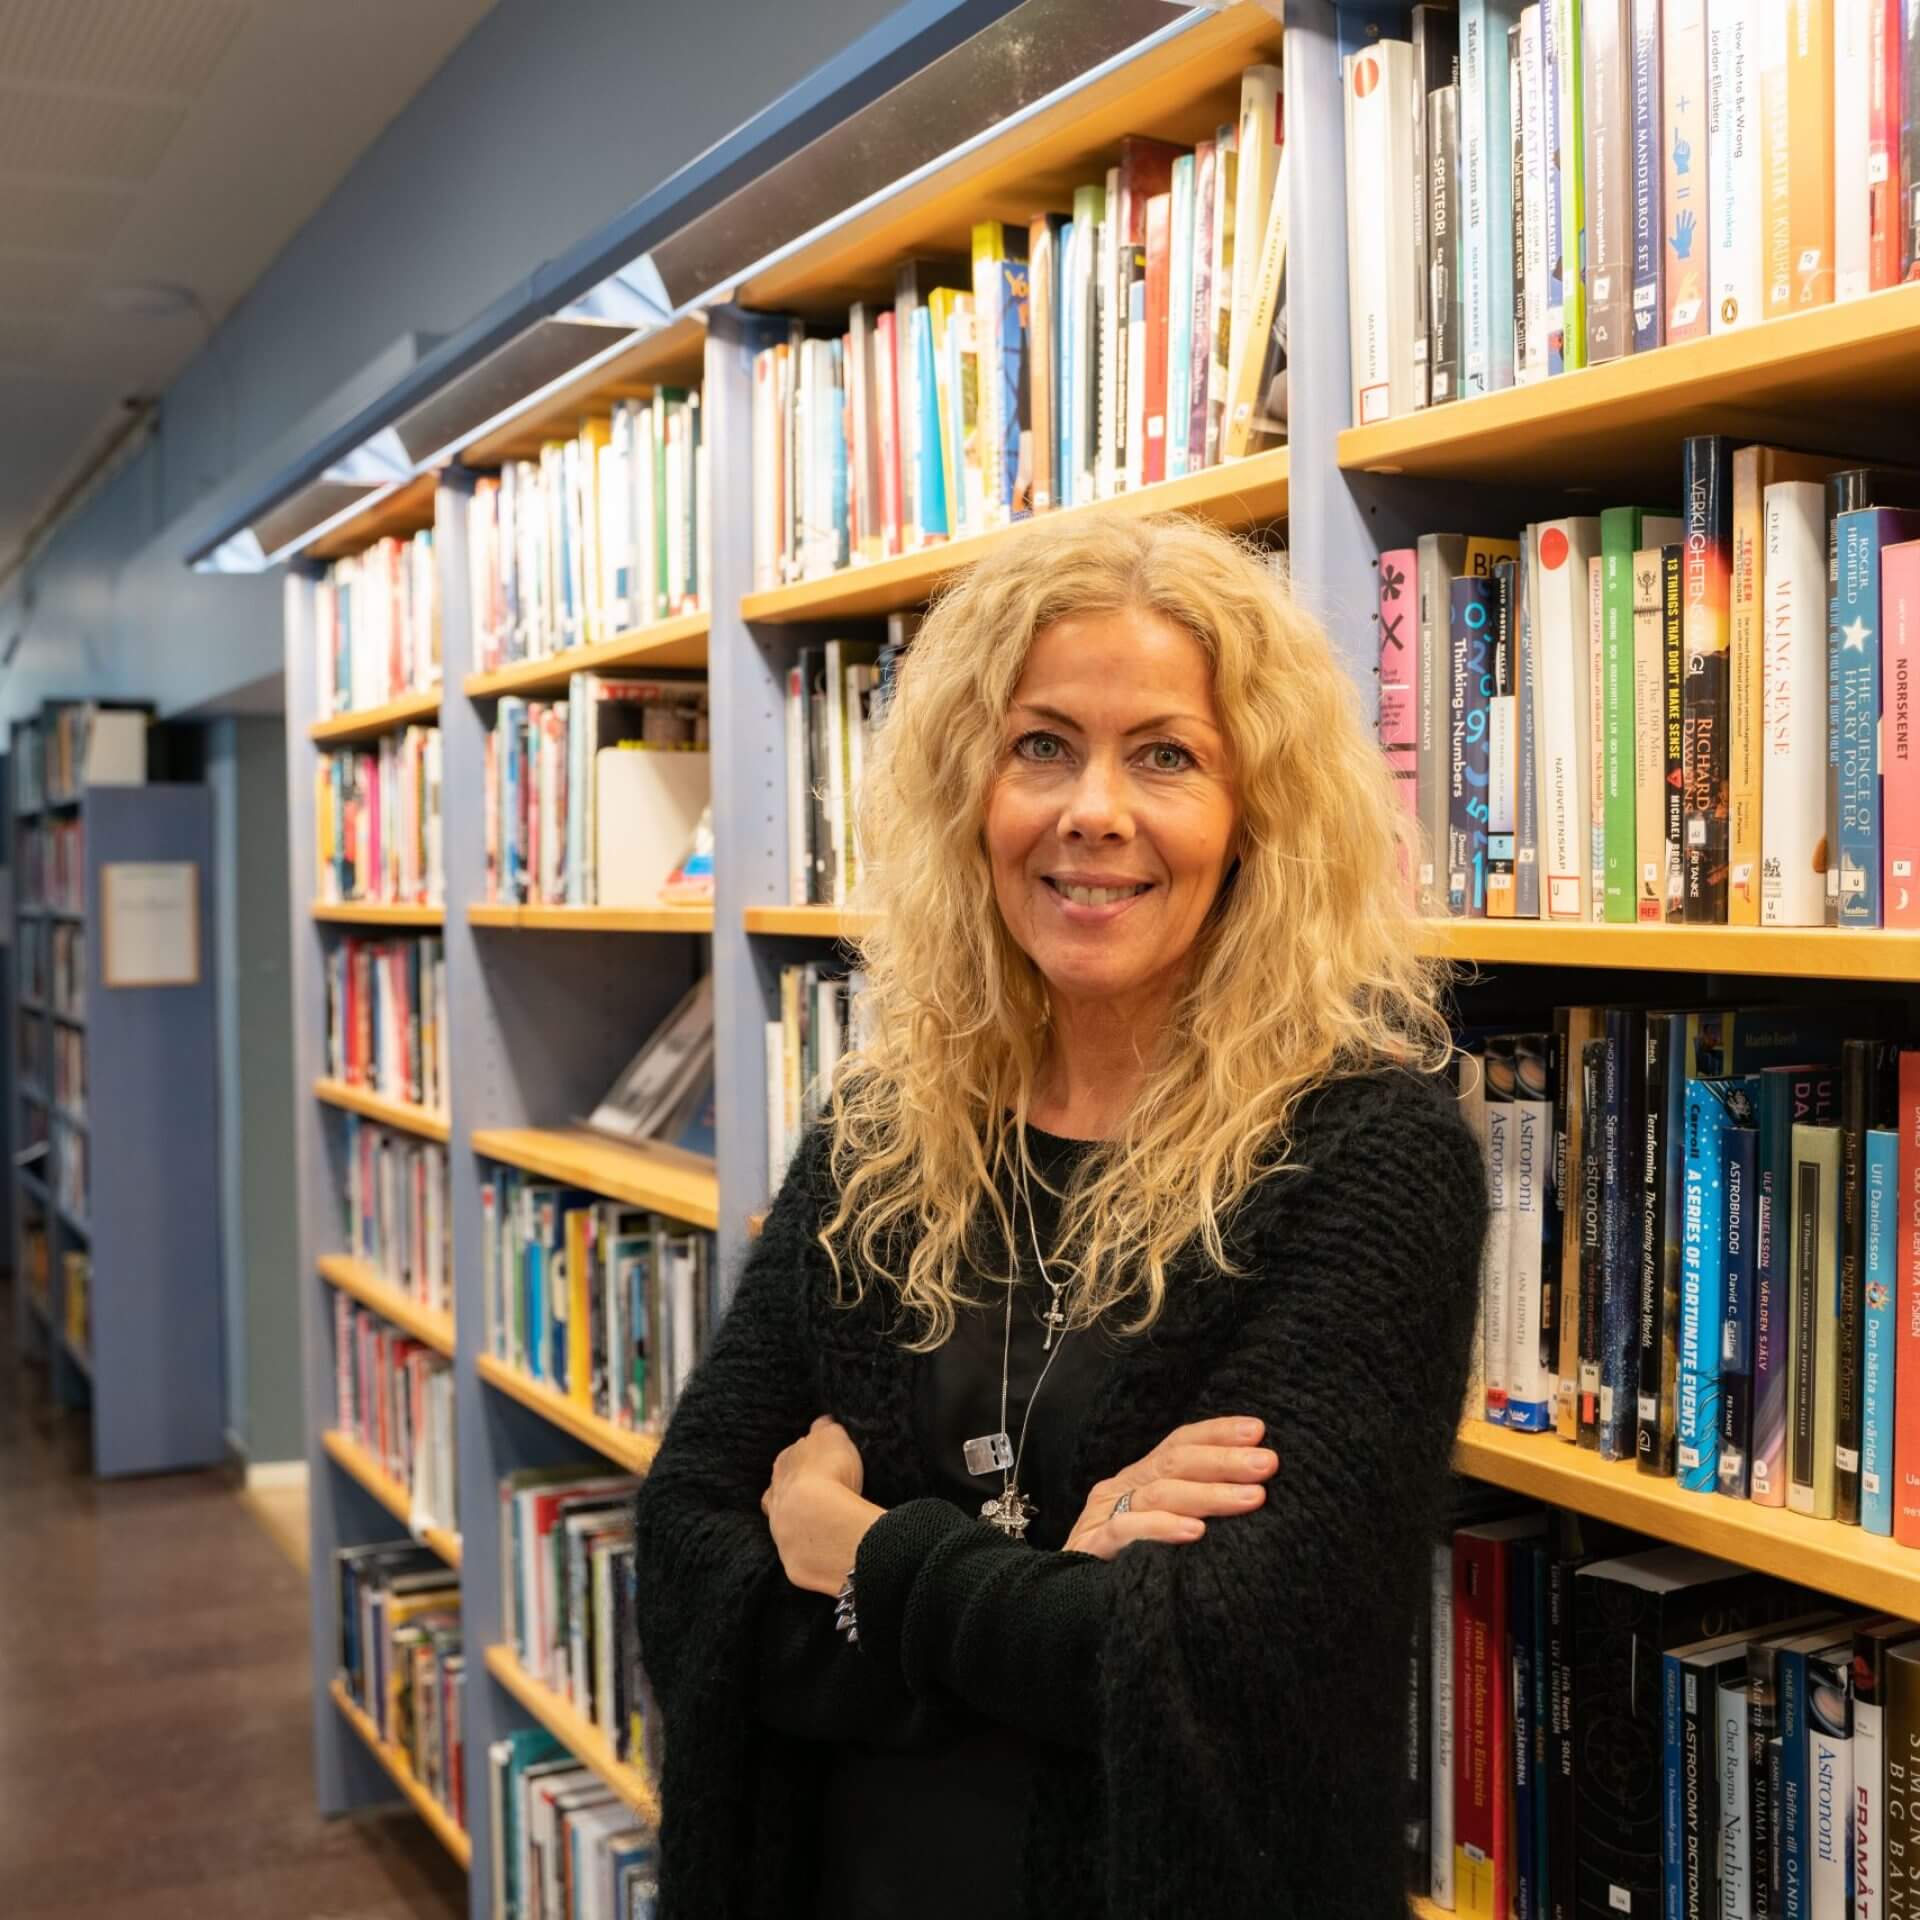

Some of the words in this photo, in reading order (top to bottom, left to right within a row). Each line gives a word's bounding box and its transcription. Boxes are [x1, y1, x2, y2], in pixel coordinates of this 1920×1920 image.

[1710, 28, 1721, 71] Jordan
[1734, 21, 1745, 51] How
[1735, 54, 1745, 79] Not
[1735, 80, 1744, 93] to
[1524, 37, 1538, 179] MATEMATIK
[1710, 73, 1722, 134] Ellenberg
[1735, 97, 1745, 112] Be
[1733, 115, 1745, 160] Wrong
[1434, 157, 1446, 237] SPELTEORI
[1514, 178, 1522, 200] som
[1637, 128, 1650, 241] MANDELBROT
[1470, 199, 1480, 228] allt
[1515, 214, 1523, 238] värt
[1722, 196, 1735, 249] Thinking
[1515, 239, 1523, 254] att
[1515, 255, 1523, 280] veta
[1638, 243, 1649, 273] SET
[1515, 289, 1526, 319] Tony
[1367, 313, 1377, 381] MATEMATIK
[1769, 512, 1780, 555] DEAN
[1667, 558, 1678, 572] 13
[1743, 538, 1753, 603] TEORIER
[1847, 526, 1858, 605] HIGHFIELD
[1858, 536, 1870, 591] ROGER
[1667, 574, 1679, 618] THINGS
[1668, 619, 1679, 648] THAT
[1775, 580, 1792, 673] MAKING
[1451, 637, 1467, 709] Thinking
[1499, 644, 1507, 686] WALLACE
[1667, 650, 1680, 686] DON'T
[1857, 664, 1871, 706] THE
[1636, 660, 1650, 727] Influential
[1648, 680, 1660, 707] The
[1668, 688, 1680, 720] MAKE
[1844, 669, 1858, 742] HARRY
[1895, 657, 1909, 762] NORRSKENET
[1423, 707, 1434, 752] ANALYS
[1525, 711, 1534, 733] och
[1648, 709, 1661, 733] 100
[1774, 681, 1792, 757] SENSE
[1452, 721, 1468, 799] Numbers
[1637, 729, 1650, 787] Scientists
[1649, 735, 1662, 768] Most
[1669, 722, 1681, 760] SENSE
[1857, 710, 1872, 802] SCIENCE
[1683, 718, 1697, 817] DAWKINS
[1695, 717, 1713, 813] RICHARD
[1523, 751, 1535, 846] vardagsmatematik
[1843, 749, 1857, 834] POTTER
[1554, 756, 1568, 871] NATURVETENSKAP
[1669, 795, 1681, 842] MICHAEL
[1736, 817, 1744, 845] Parsons
[1858, 806, 1872, 837] OF
[1457, 833, 1467, 866] Daniel
[1690, 850, 1699, 865] FRI
[1690, 866, 1700, 899] TANKE
[1647, 1039, 1657, 1065] Beech
[1605, 1114, 1618, 1185] Stjärnhimlen
[1645, 1112, 1658, 1184] Terraforming
[1690, 1104, 1701, 1159] Carroll
[1843, 1131, 1856, 1159] John
[1490, 1110, 1509, 1214] Astronomi
[1518, 1108, 1538, 1214] Astronomi
[1555, 1131, 1568, 1213] Astrobiologi
[1687, 1168, 1702, 1182] A
[1762, 1170, 1772, 1194] ULF
[1871, 1162, 1883, 1184] Ulf
[1585, 1154, 1602, 1248] astronomi
[1645, 1191, 1656, 1209] The
[1685, 1184, 1702, 1243] SERIES
[1727, 1160, 1741, 1256] ASTROBIOLOGI
[1803, 1213, 1811, 1227] Ulf
[1843, 1180, 1856, 1224] Barrow
[1643, 1210, 1655, 1252] Creating
[1760, 1195, 1772, 1268] DANIELSSON
[1869, 1189, 1882, 1271] Danielsson
[1643, 1252, 1655, 1266] of
[1685, 1245, 1700, 1269] OF
[1518, 1271, 1529, 1292] IAN
[1604, 1268, 1612, 1304] NATTEN
[1642, 1265, 1654, 1314] Habitable
[1727, 1272, 1738, 1304] David
[1516, 1295, 1528, 1345] RIDPATH
[1682, 1271, 1700, 1370] FORTUNATE
[1727, 1305, 1737, 1317] C.
[1759, 1279, 1771, 1332] VÄRLDEN
[1801, 1287, 1809, 1329] STJÄRNOR
[1840, 1255, 1856, 1353] UNIVERSUMS
[1911, 1291, 1920, 1338] FYSIKEN
[1641, 1313, 1653, 1349] Worlds
[1867, 1318, 1880, 1348] Den
[1758, 1334, 1769, 1371] SJÄLV
[1801, 1352, 1810, 1384] ÄPPLEN
[1866, 1351, 1880, 1393] bästa
[1680, 1373, 1697, 1439] EVENTS
[1840, 1358, 1853, 1421] FÖDELSE
[1866, 1397, 1877, 1415] av
[1724, 1409, 1733, 1438] TANKE
[1799, 1407, 1807, 1437] FALLER
[1864, 1419, 1877, 1473] världar
[1551, 1592, 1561, 1625] Newth
[1439, 1619, 1449, 1681] universum
[1474, 1620, 1488, 1660] From
[1551, 1639, 1560, 1659] LIV
[1463, 1657, 1473, 1669] of
[1561, 1664, 1571, 1693] Eirik
[1784, 1667, 1795, 1698] MARIE
[1473, 1663, 1488, 1726] Eudoxus
[1535, 1680, 1544, 1716] Newth
[1551, 1670, 1561, 1735] UNIVERSUM
[1561, 1695, 1571, 1731] Newth
[1752, 1677, 1765, 1728] Martin
[1474, 1729, 1486, 1745] to
[1515, 1717, 1528, 1787] STJÄRNORNA
[1535, 1725, 1546, 1763] MÅNEN
[1726, 1718, 1740, 1751] Chet
[1753, 1731, 1766, 1766] Rees
[1473, 1747, 1487, 1808] Einstein
[1561, 1739, 1572, 1777] SOLEN
[1685, 1718, 1699, 1830] ASTRONOMY
[1772, 1755, 1780, 1791] PLANETS
[1723, 1755, 1740, 1805] Raymo
[1889, 1760, 1905, 1822] BIG
[1909, 1733, 1920, 1848] SIMON
[1754, 1778, 1767, 1841] SUMMA
[1785, 1780, 1799, 1832] Härifrån
[1818, 1744, 1838, 1864] Astronomi
[1754, 1848, 1768, 1875] SEX
[1786, 1835, 1798, 1853] till
[1856, 1785, 1874, 1920] FRAMÅT
